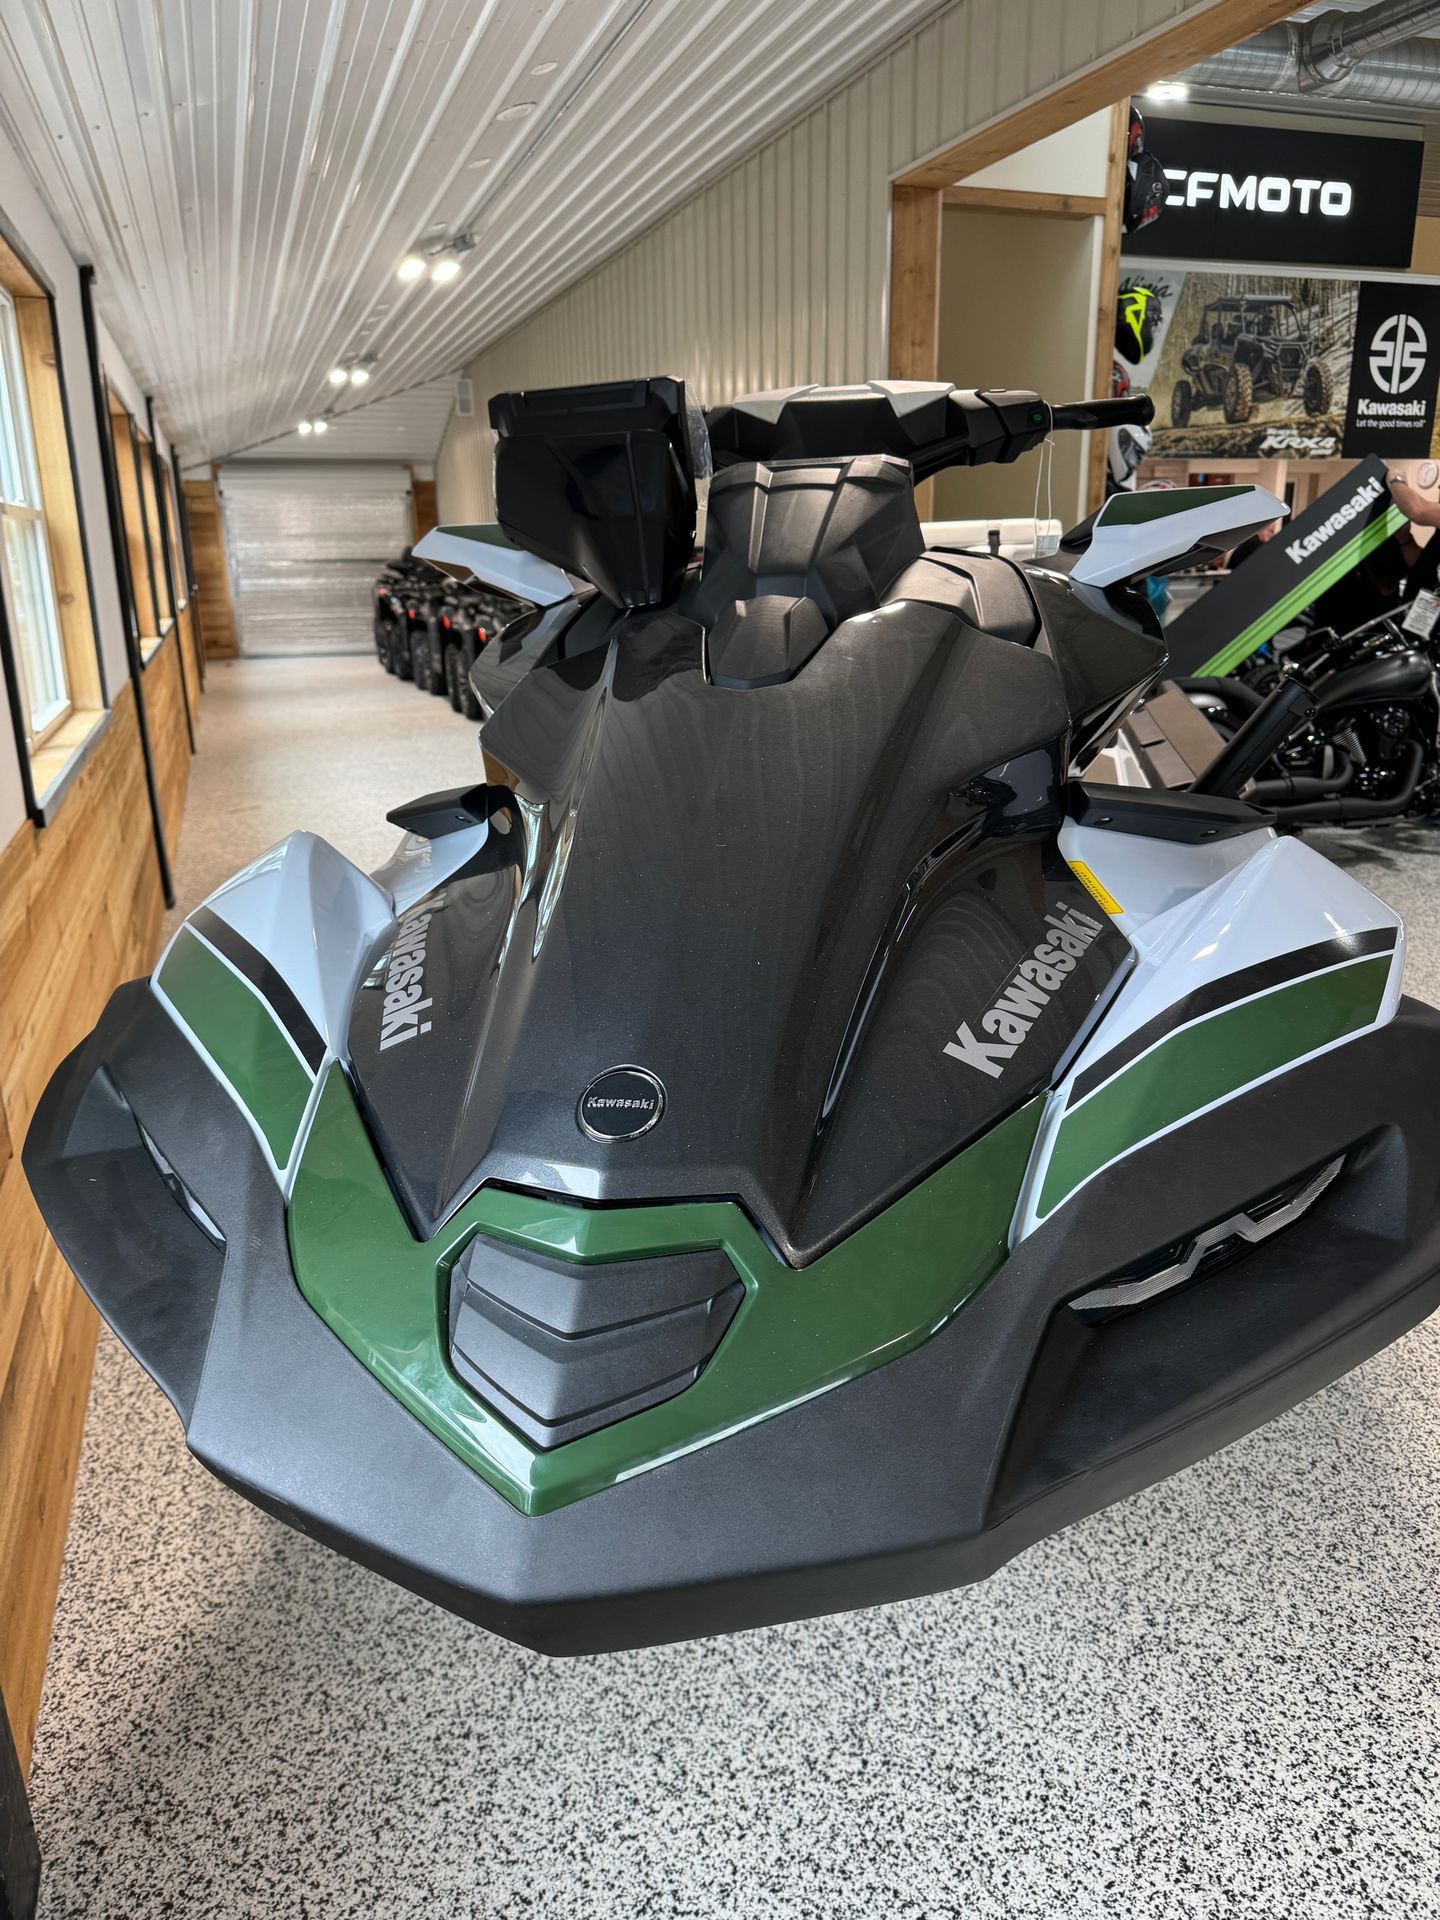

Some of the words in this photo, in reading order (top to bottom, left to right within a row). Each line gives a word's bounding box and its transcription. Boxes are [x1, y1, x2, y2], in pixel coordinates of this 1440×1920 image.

[1357, 398, 1427, 416] Kawasaki
[1356, 418, 1367, 428] Let
[1367, 418, 1378, 428] the
[1378, 418, 1395, 430] good
[1396, 419, 1412, 428] times
[1285, 476, 1385, 565] Kawasaki
[942, 901, 1104, 1079] Kawasaki
[586, 1095, 655, 1112] Kawasaki
